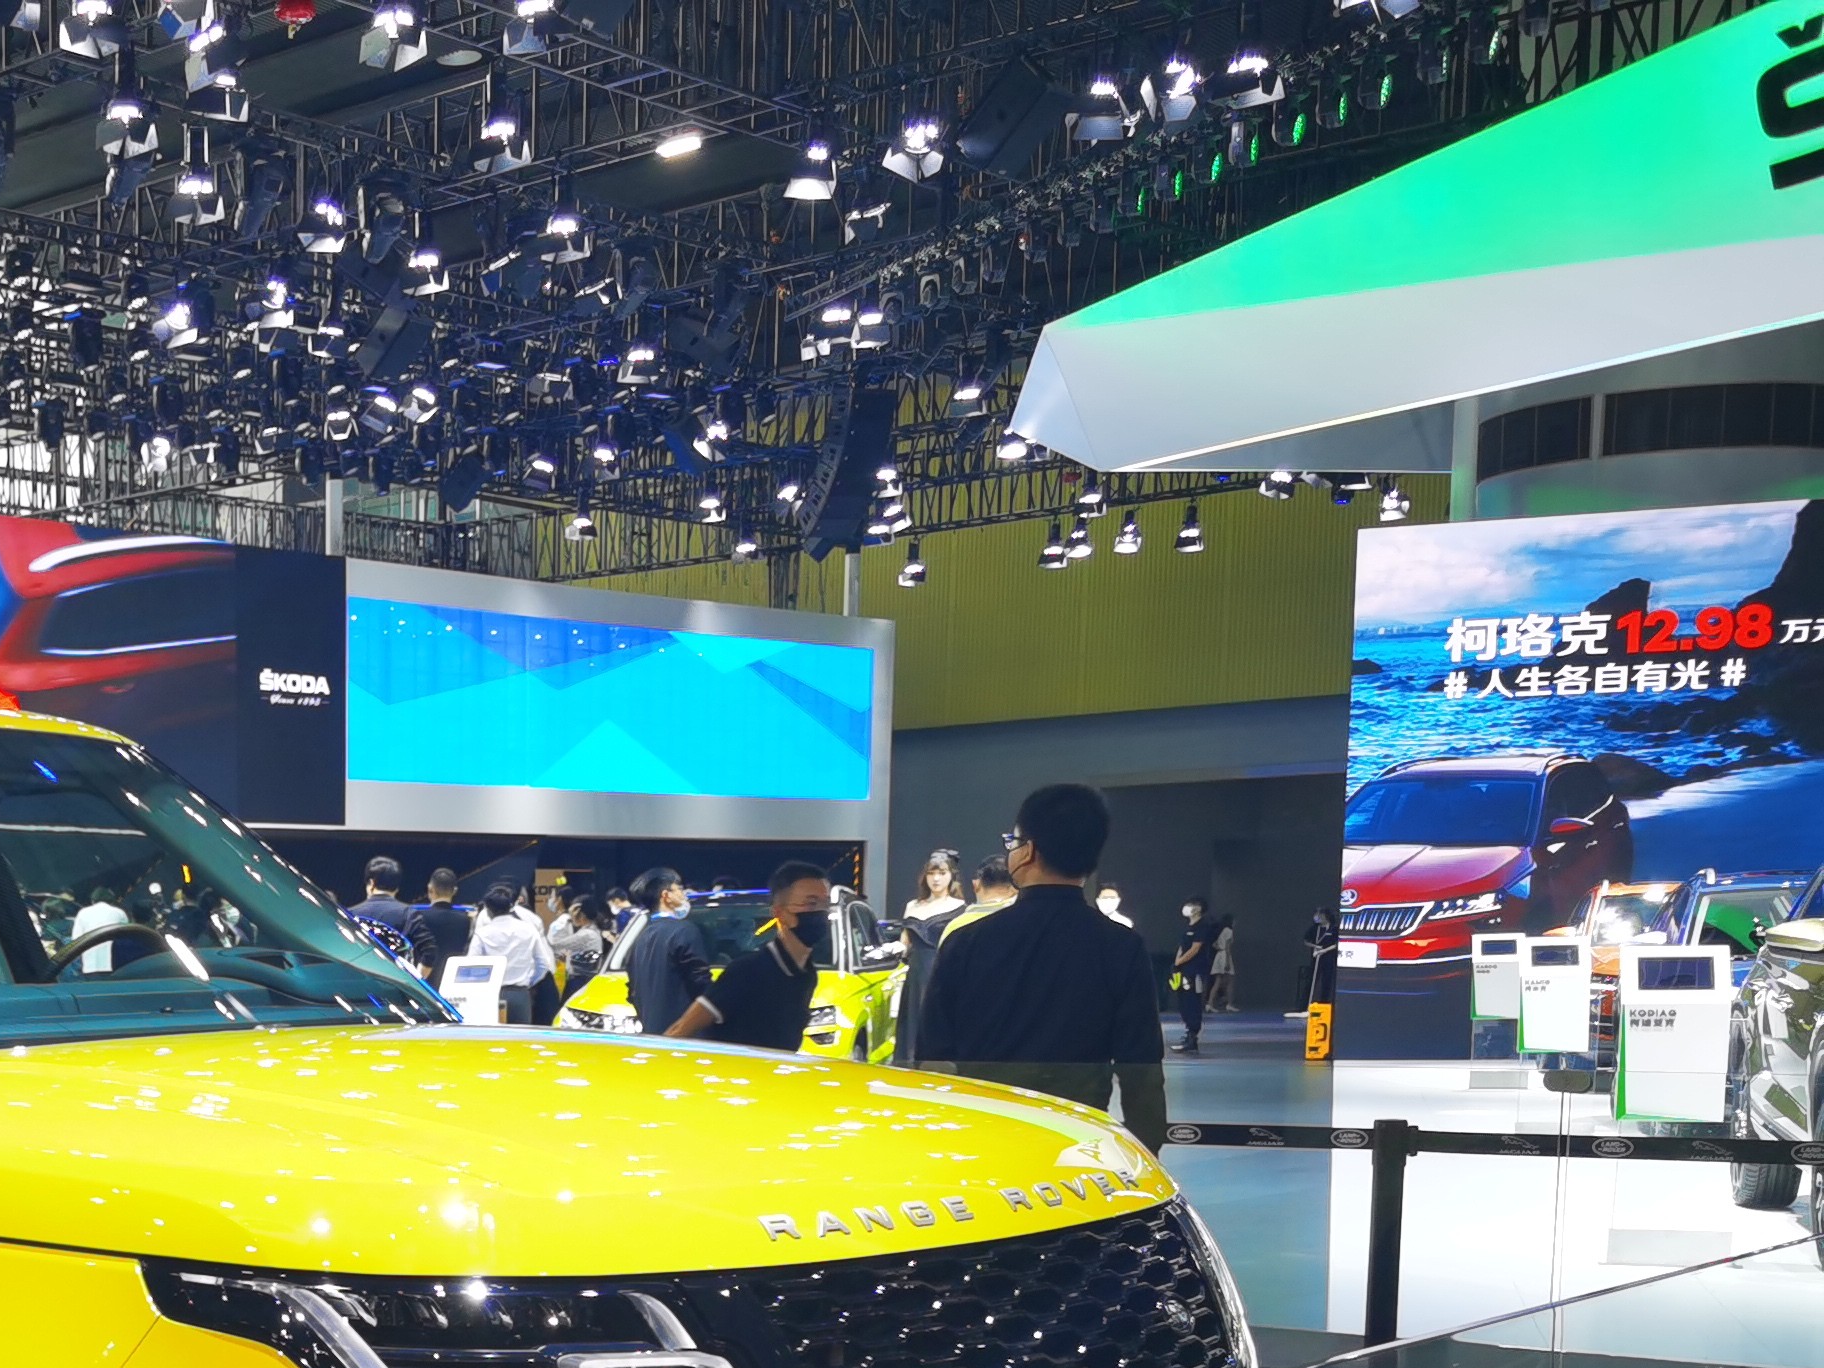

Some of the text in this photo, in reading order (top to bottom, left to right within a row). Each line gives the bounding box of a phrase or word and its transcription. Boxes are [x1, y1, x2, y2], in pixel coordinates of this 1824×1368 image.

[1444, 611, 1612, 662] 柯珞克
[1616, 602, 1774, 654] 12.98
[259, 667, 330, 695] ŠKODA
[758, 1167, 1140, 1242] RANGE ROVER
